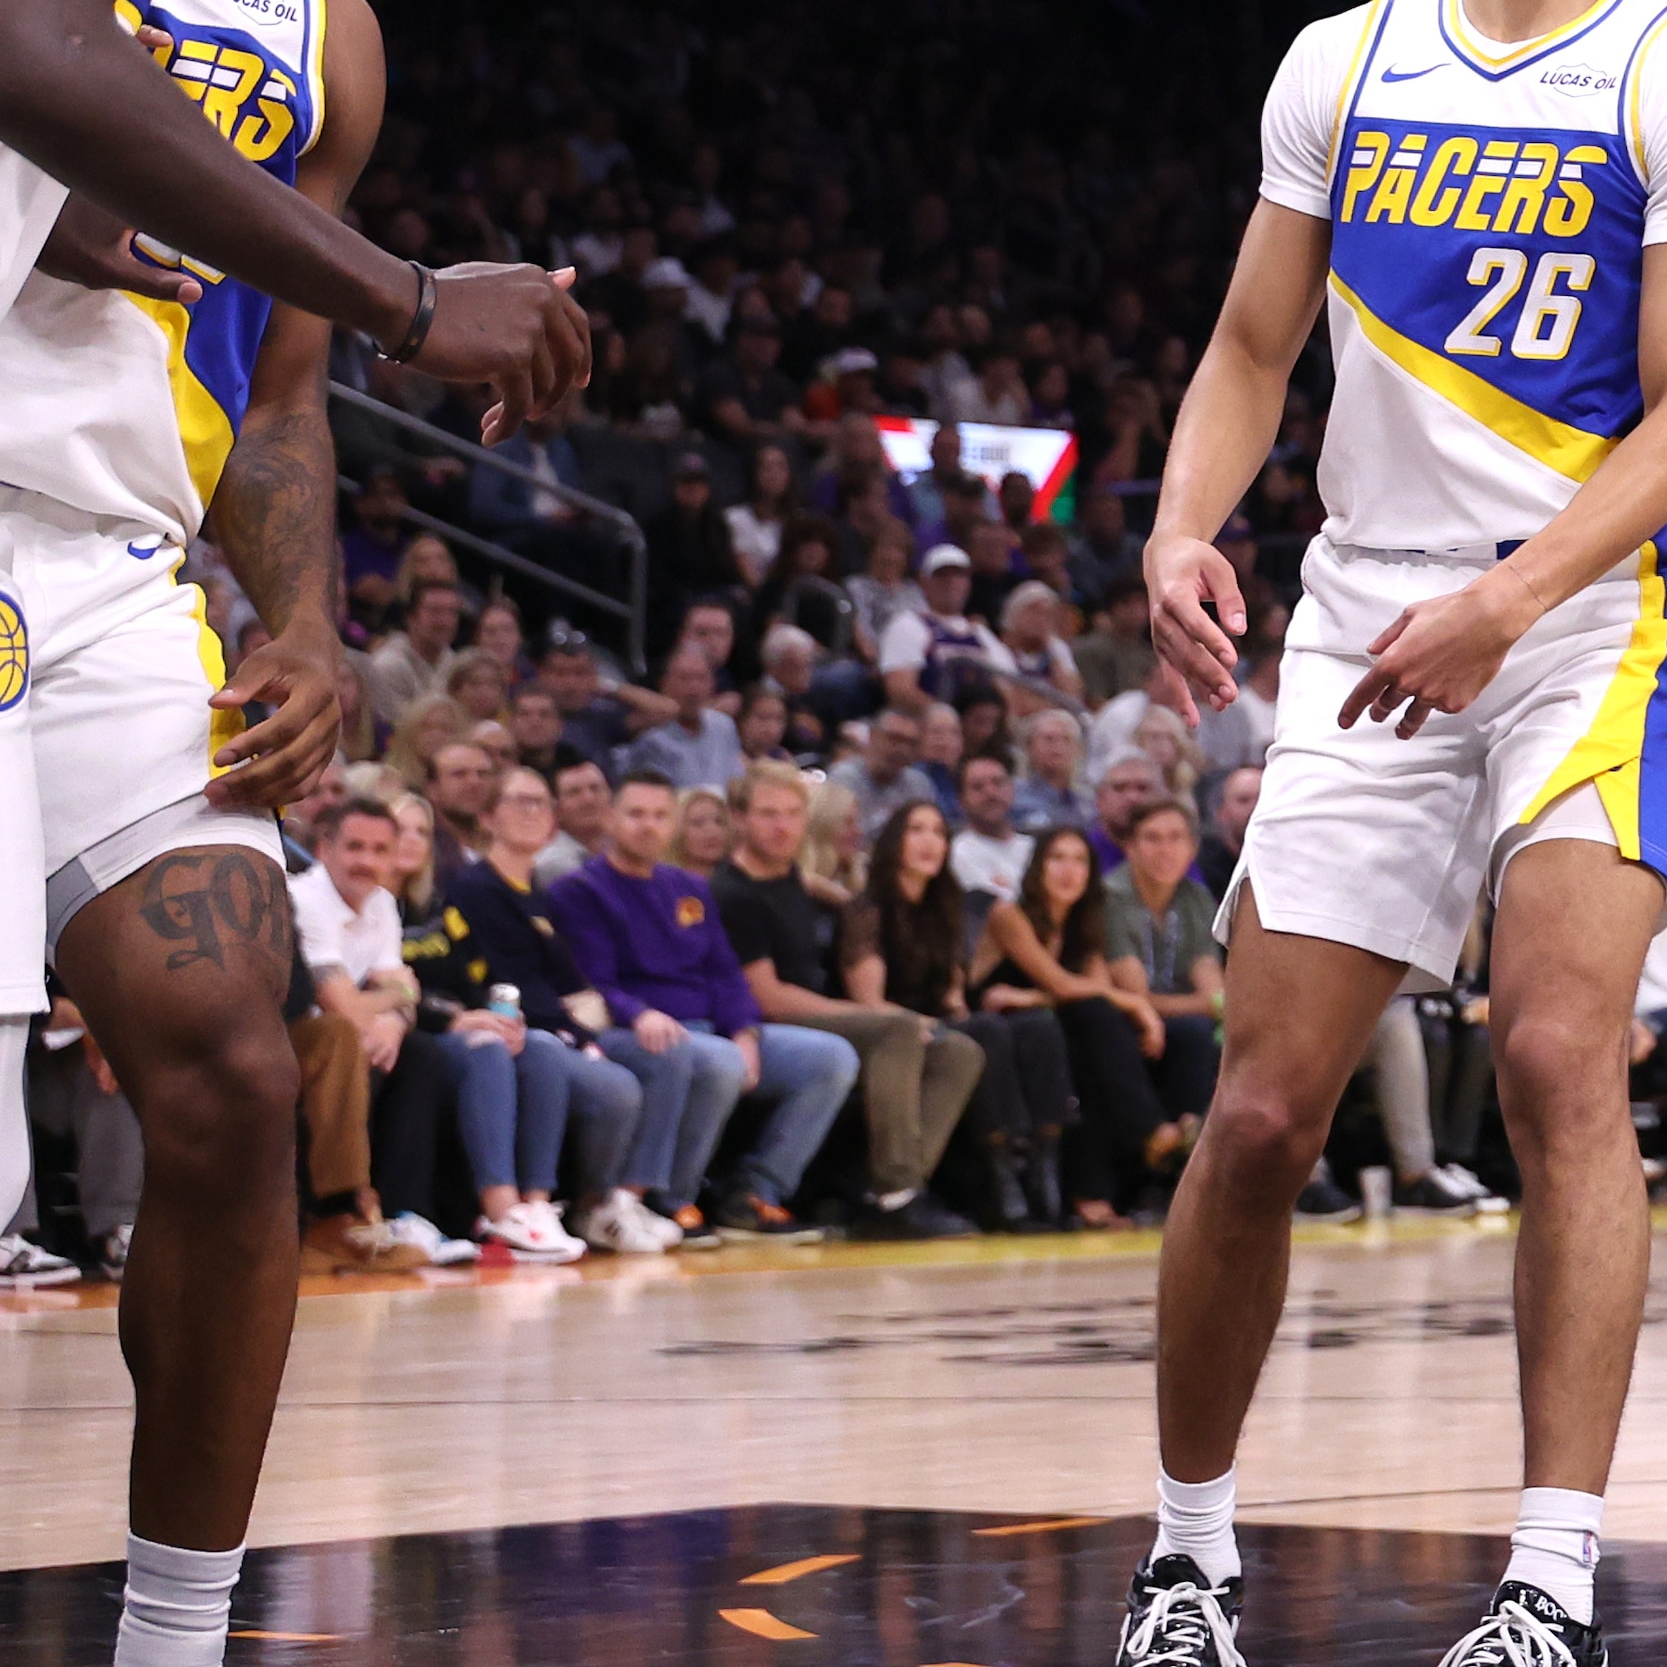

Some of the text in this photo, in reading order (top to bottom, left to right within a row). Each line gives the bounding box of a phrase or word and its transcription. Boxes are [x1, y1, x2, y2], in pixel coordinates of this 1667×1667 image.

[273, 2, 299, 23] OIL
[153, 40, 297, 162] ERS
[1540, 71, 1617, 90] LUCAS OIL
[1340, 131, 1608, 238] PACERS
[1444, 246, 1597, 362] 26
